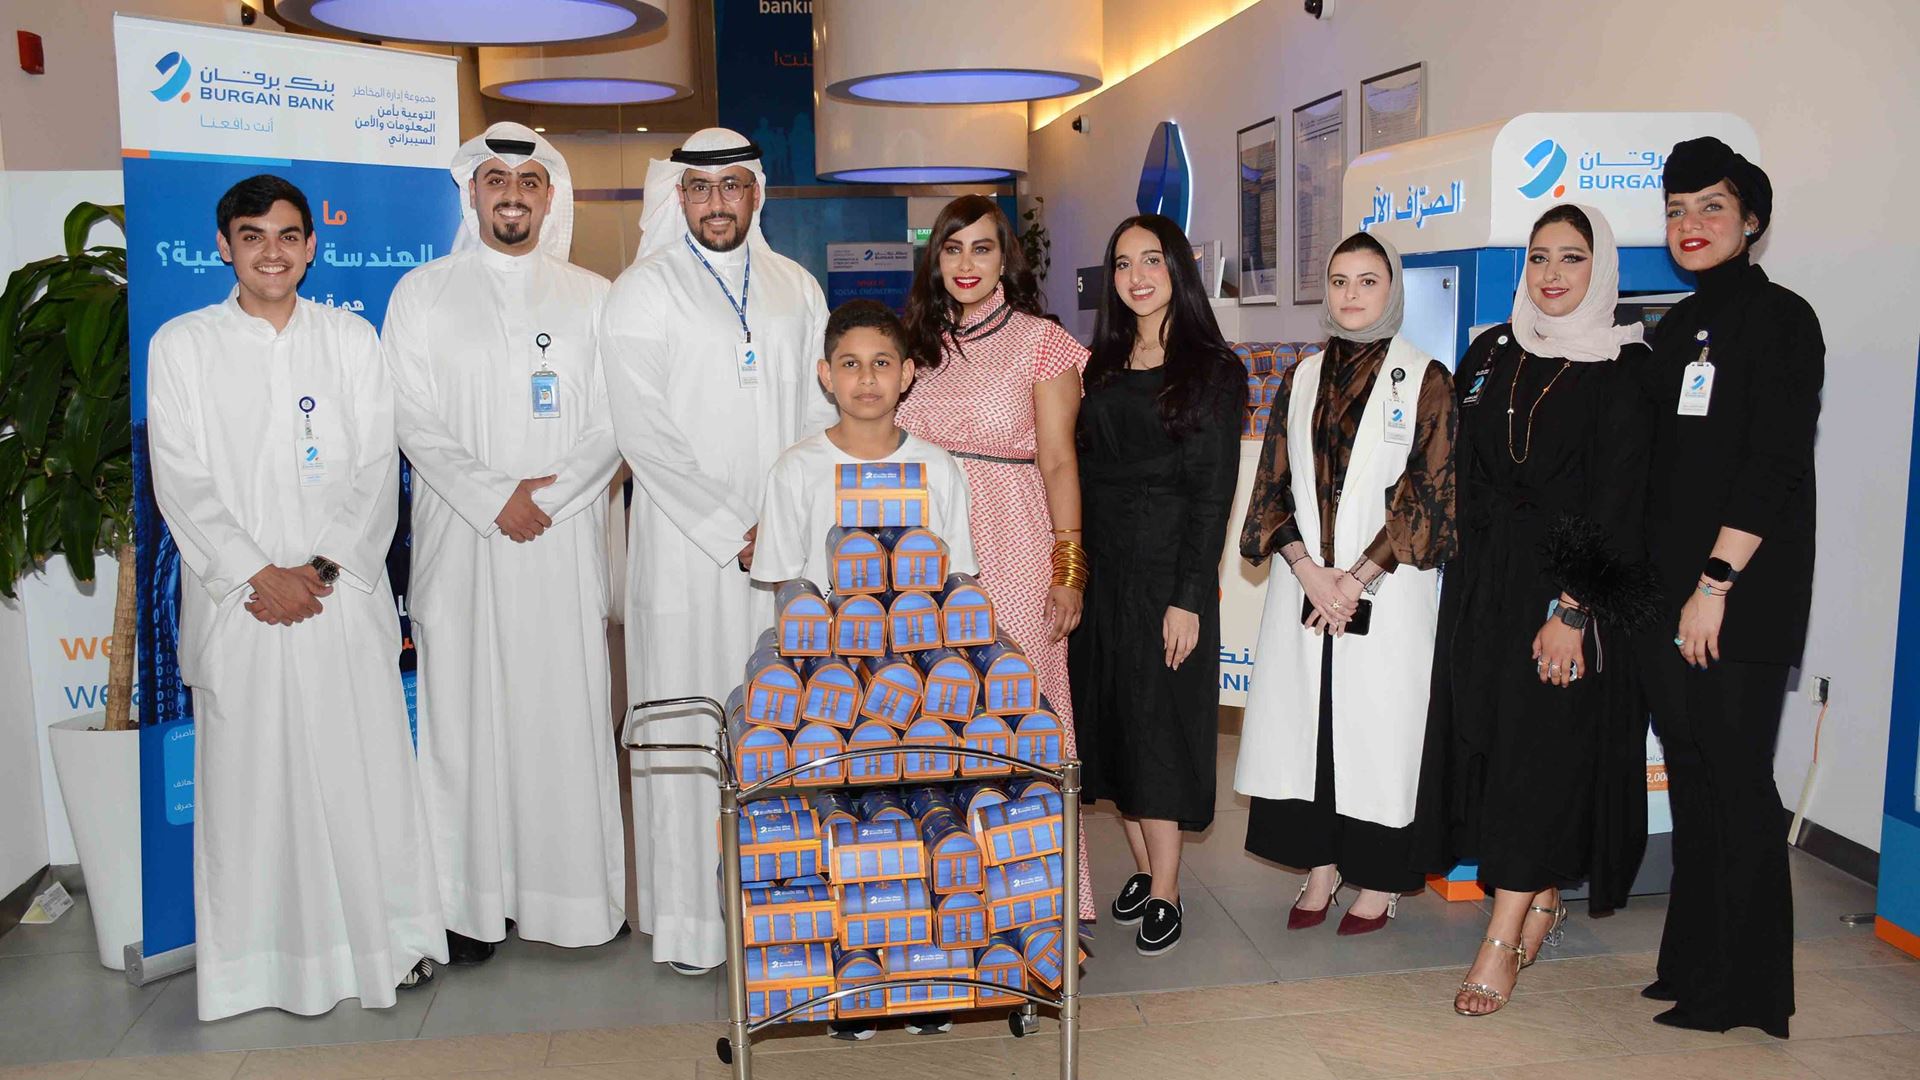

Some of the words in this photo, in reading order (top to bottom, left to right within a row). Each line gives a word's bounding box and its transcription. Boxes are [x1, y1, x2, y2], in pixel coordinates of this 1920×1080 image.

[760, 0, 813, 14] banki
[200, 66, 280, 91] برقان
[285, 76, 335, 97] بنك
[200, 87, 280, 106] BURGAN
[288, 95, 334, 112] BANK
[377, 104, 400, 120] بأمن
[401, 107, 436, 121] التوعية
[200, 115, 252, 131] دافعنا
[354, 115, 385, 131] والأمن
[386, 120, 436, 133] المعلومات
[388, 133, 436, 148] السيبراني
[322, 200, 348, 226] ما
[323, 241, 434, 268] الهندسة
[1077, 276, 1084, 293] 5
